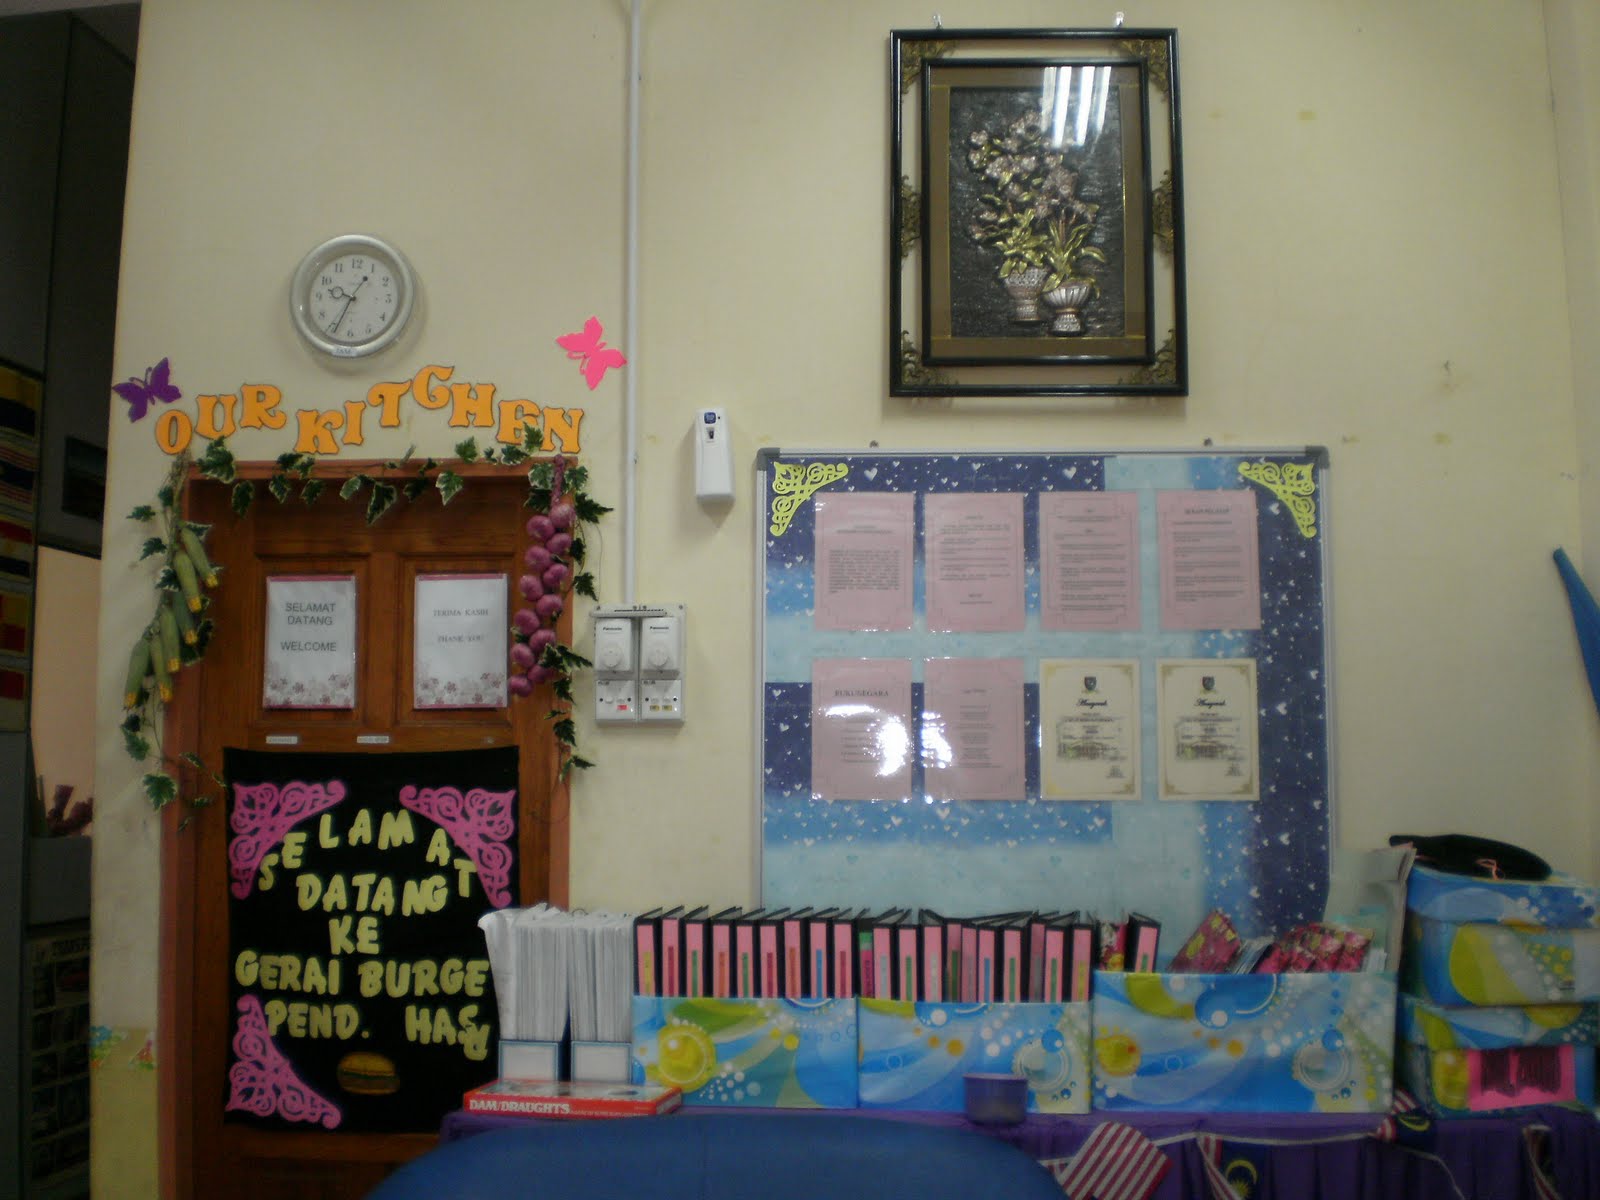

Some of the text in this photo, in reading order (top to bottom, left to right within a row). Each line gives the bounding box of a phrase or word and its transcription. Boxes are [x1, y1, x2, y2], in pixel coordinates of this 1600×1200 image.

[335, 263, 343, 273] 11
[352, 258, 363, 269] 12
[371, 263, 376, 273] 1
[321, 276, 332, 286] 10
[382, 276, 389, 287] 2
[155, 365, 585, 455] OUR KITCHEN
[285, 602, 337, 613] SELAMAT
[433, 609, 462, 617] TERIMA
[287, 615, 333, 626] DATANG
[280, 641, 337, 652] WELCOME
[258, 808, 477, 897] SELAMAT
[296, 873, 448, 916] DATANG
[329, 915, 380, 955] KE
[235, 950, 341, 995] GERAI
[264, 1000, 370, 1040] PEND.
